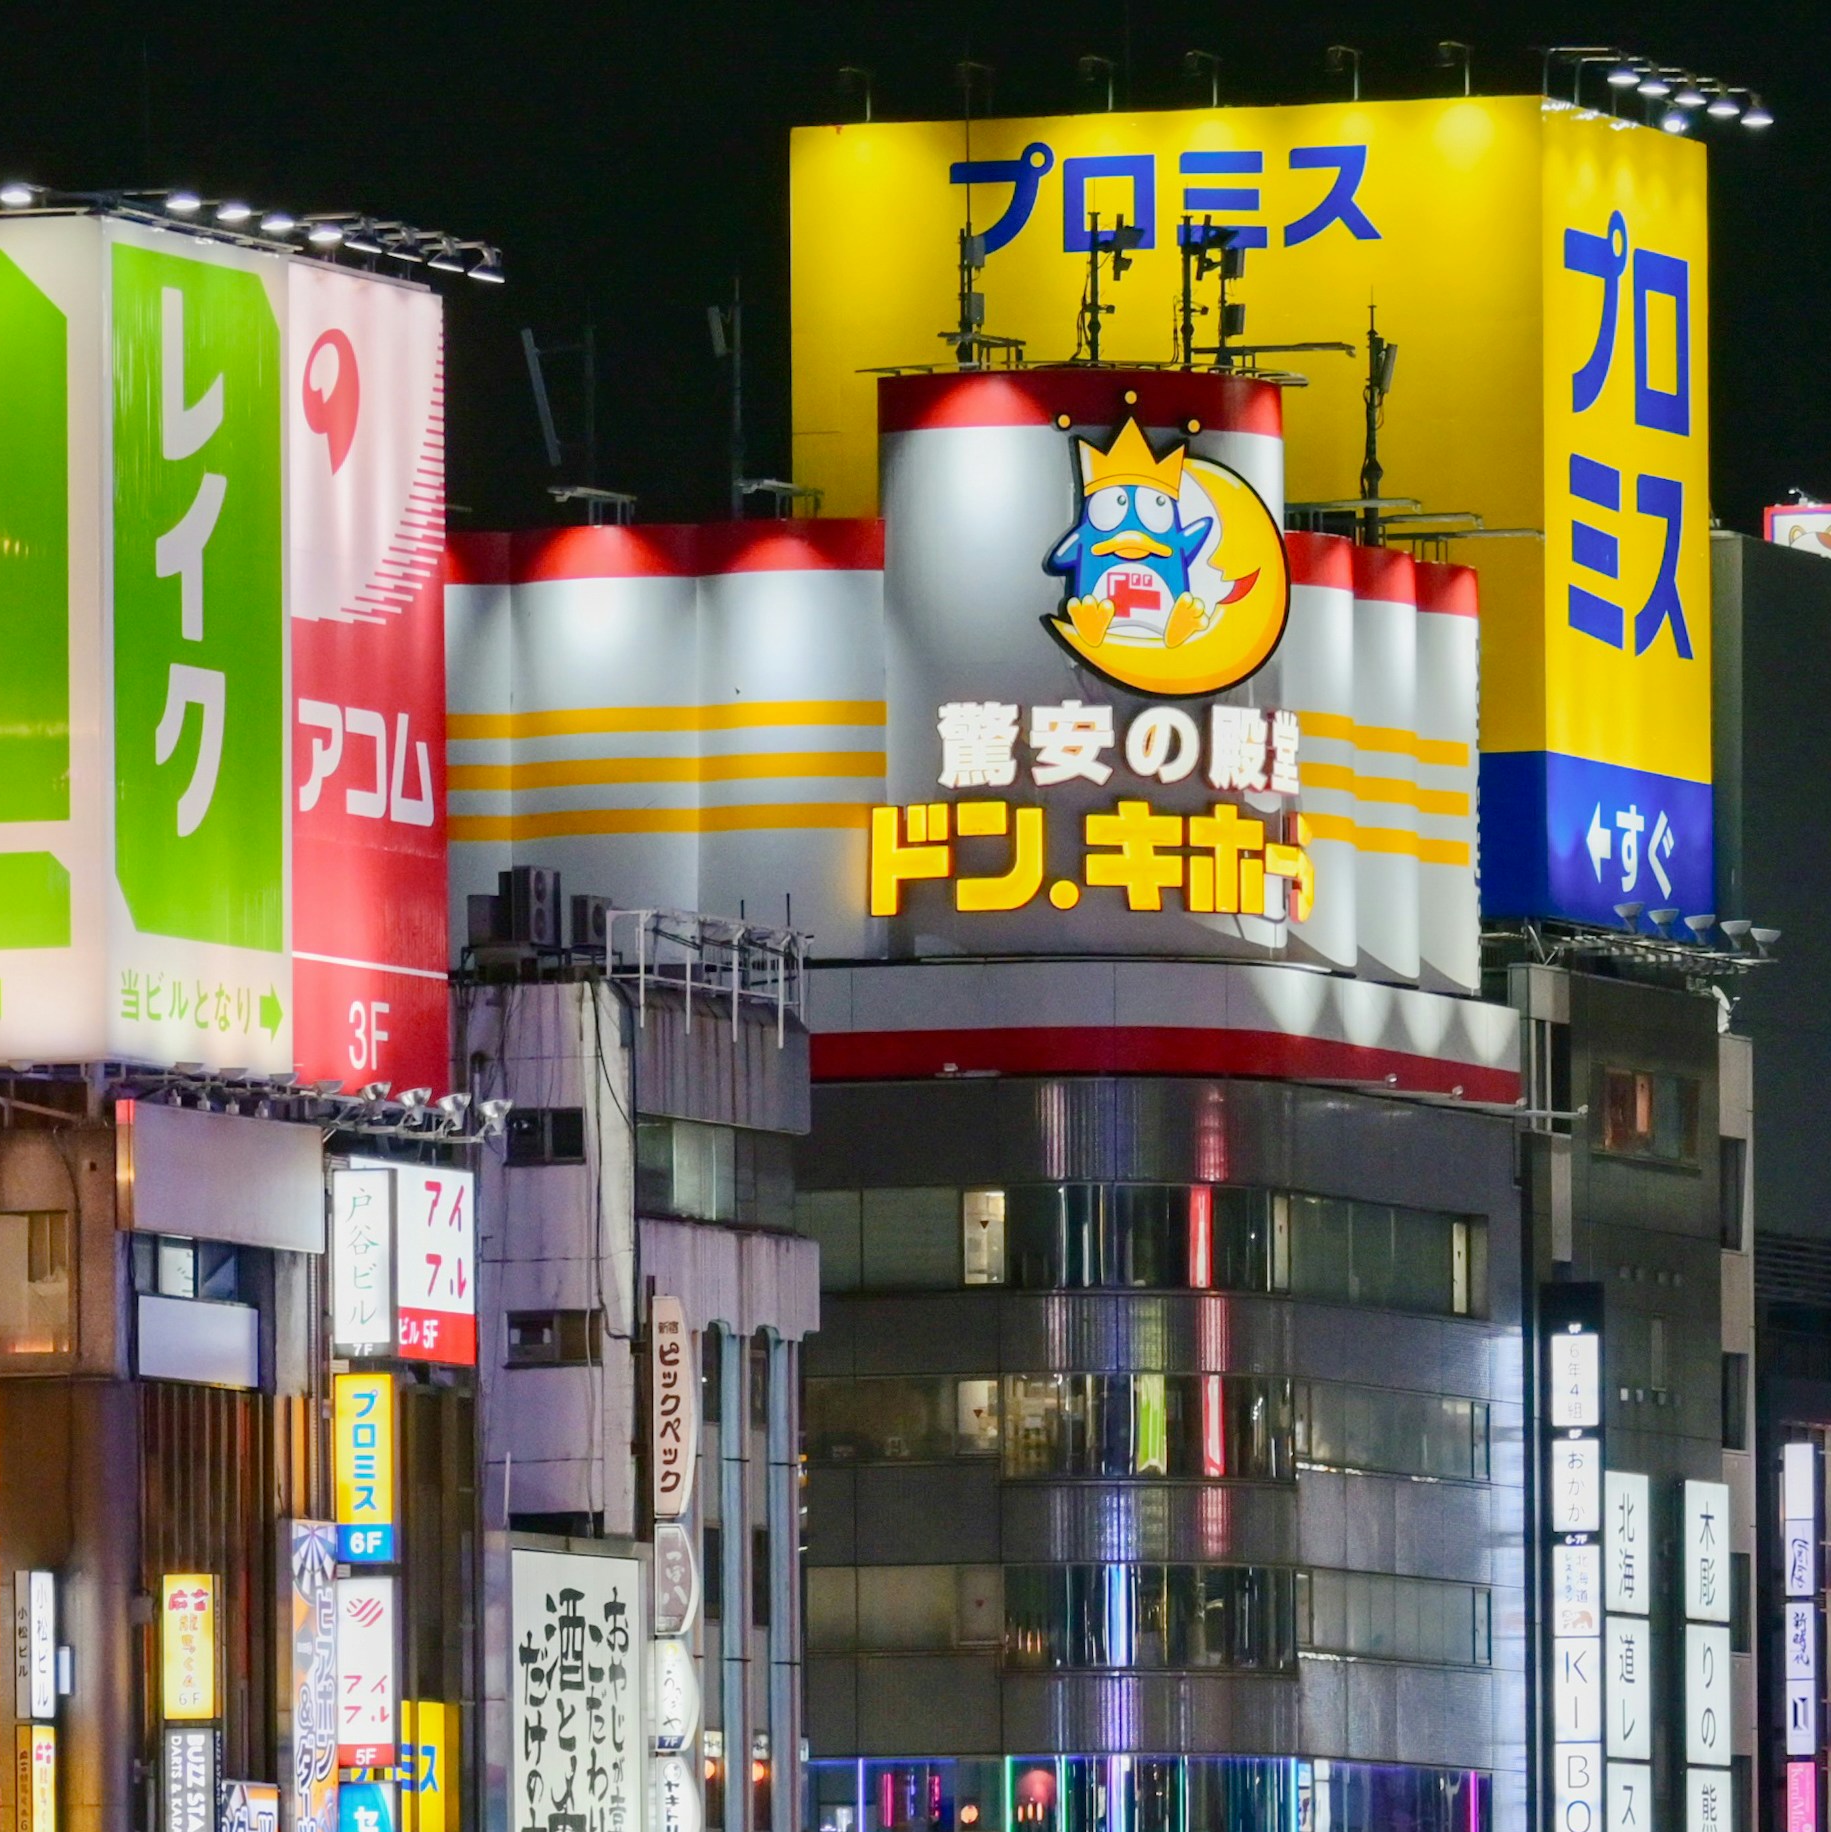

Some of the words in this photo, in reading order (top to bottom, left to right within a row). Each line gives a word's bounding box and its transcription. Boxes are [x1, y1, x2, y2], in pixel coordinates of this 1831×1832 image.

[949, 141, 1382, 255] プロミス
[1563, 210, 1692, 438] プロ
[155, 285, 227, 838] レイク
[1566, 452, 1694, 661] ミス
[297, 699, 437, 830] アコム
[936, 698, 1302, 797] 驚安の殿堂
[1615, 804, 1677, 898] すぐ
[118, 969, 257, 1033] 当ビルとなり
[347, 1000, 390, 1071] 3F
[345, 1186, 381, 1328] 戸谷ビル
[353, 1343, 373, 1358] 7F
[422, 1319, 440, 1351] 5F
[352, 1389, 380, 1513] プロミス
[1566, 1450, 1586, 1524] おかか
[350, 1532, 382, 1556] 6F
[314, 1587, 336, 1782] ビアポン
[343, 1674, 389, 1696] アイ
[343, 1705, 391, 1725] フル
[169, 1735, 184, 1781] DARTS
[186, 1733, 206, 1791] BUZZ
[355, 1747, 378, 1766] 5F
[662, 1736, 679, 1748] 7F
[169, 1783, 183, 1795] &
